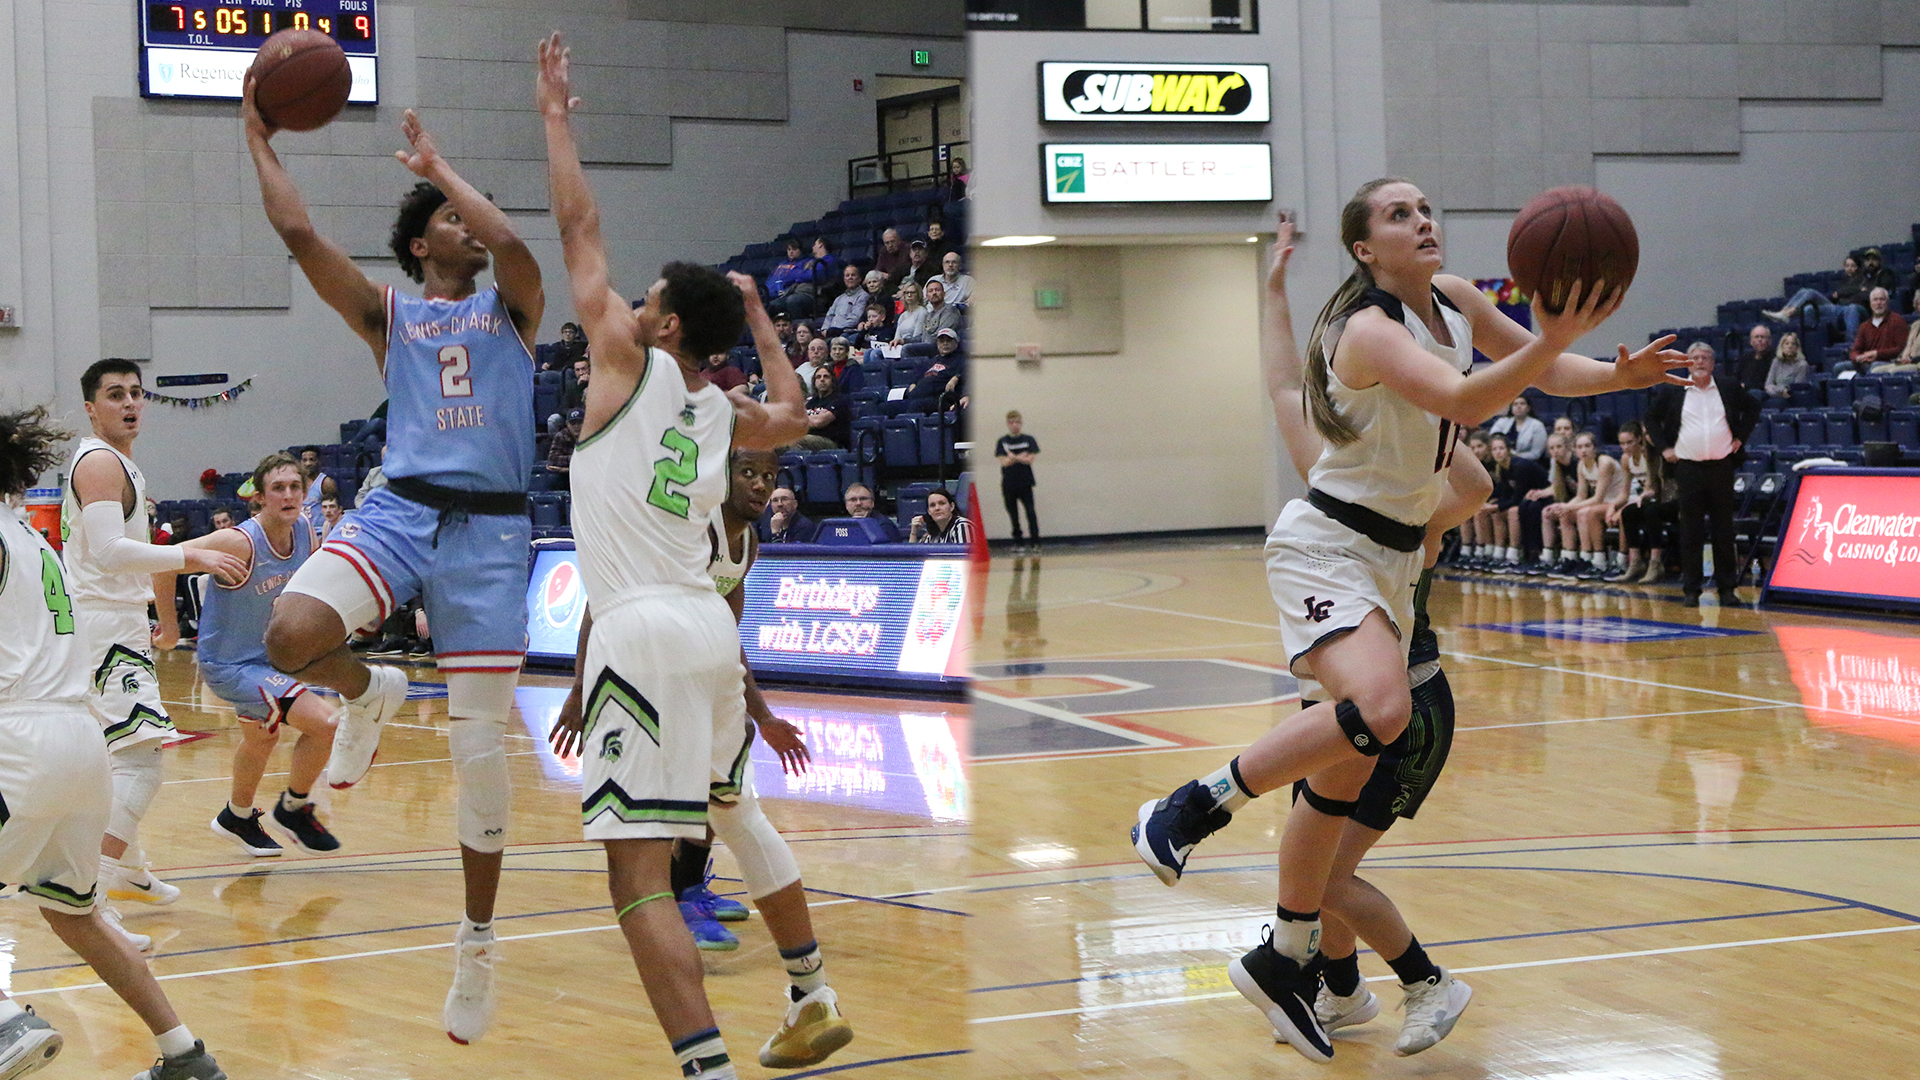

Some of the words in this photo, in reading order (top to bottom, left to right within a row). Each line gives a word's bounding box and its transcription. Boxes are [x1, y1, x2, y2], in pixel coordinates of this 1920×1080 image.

[339, 0, 368, 11] FOULS
[171, 6, 185, 30] 7
[216, 8, 247, 34] 05
[318, 18, 330, 34] 4
[355, 15, 369, 39] 9
[187, 33, 214, 45] T.O.L.
[915, 50, 930, 64] EXIT
[180, 62, 243, 84] Regence
[1070, 72, 1245, 114] SUBWAY
[938, 144, 948, 161] E
[1091, 161, 1217, 176] SATTLER
[437, 343, 474, 399] 2
[436, 405, 486, 431] STATE
[645, 426, 699, 521] 2
[835, 527, 849, 537] POSS
[1833, 503, 1920, 538] Clearwater
[1836, 542, 1885, 561] CASINO
[1883, 539, 1899, 568] &
[1898, 545, 1920, 563] LO
[40, 547, 75, 635] 4
[774, 574, 880, 618] Birthdays
[758, 616, 804, 653] with
